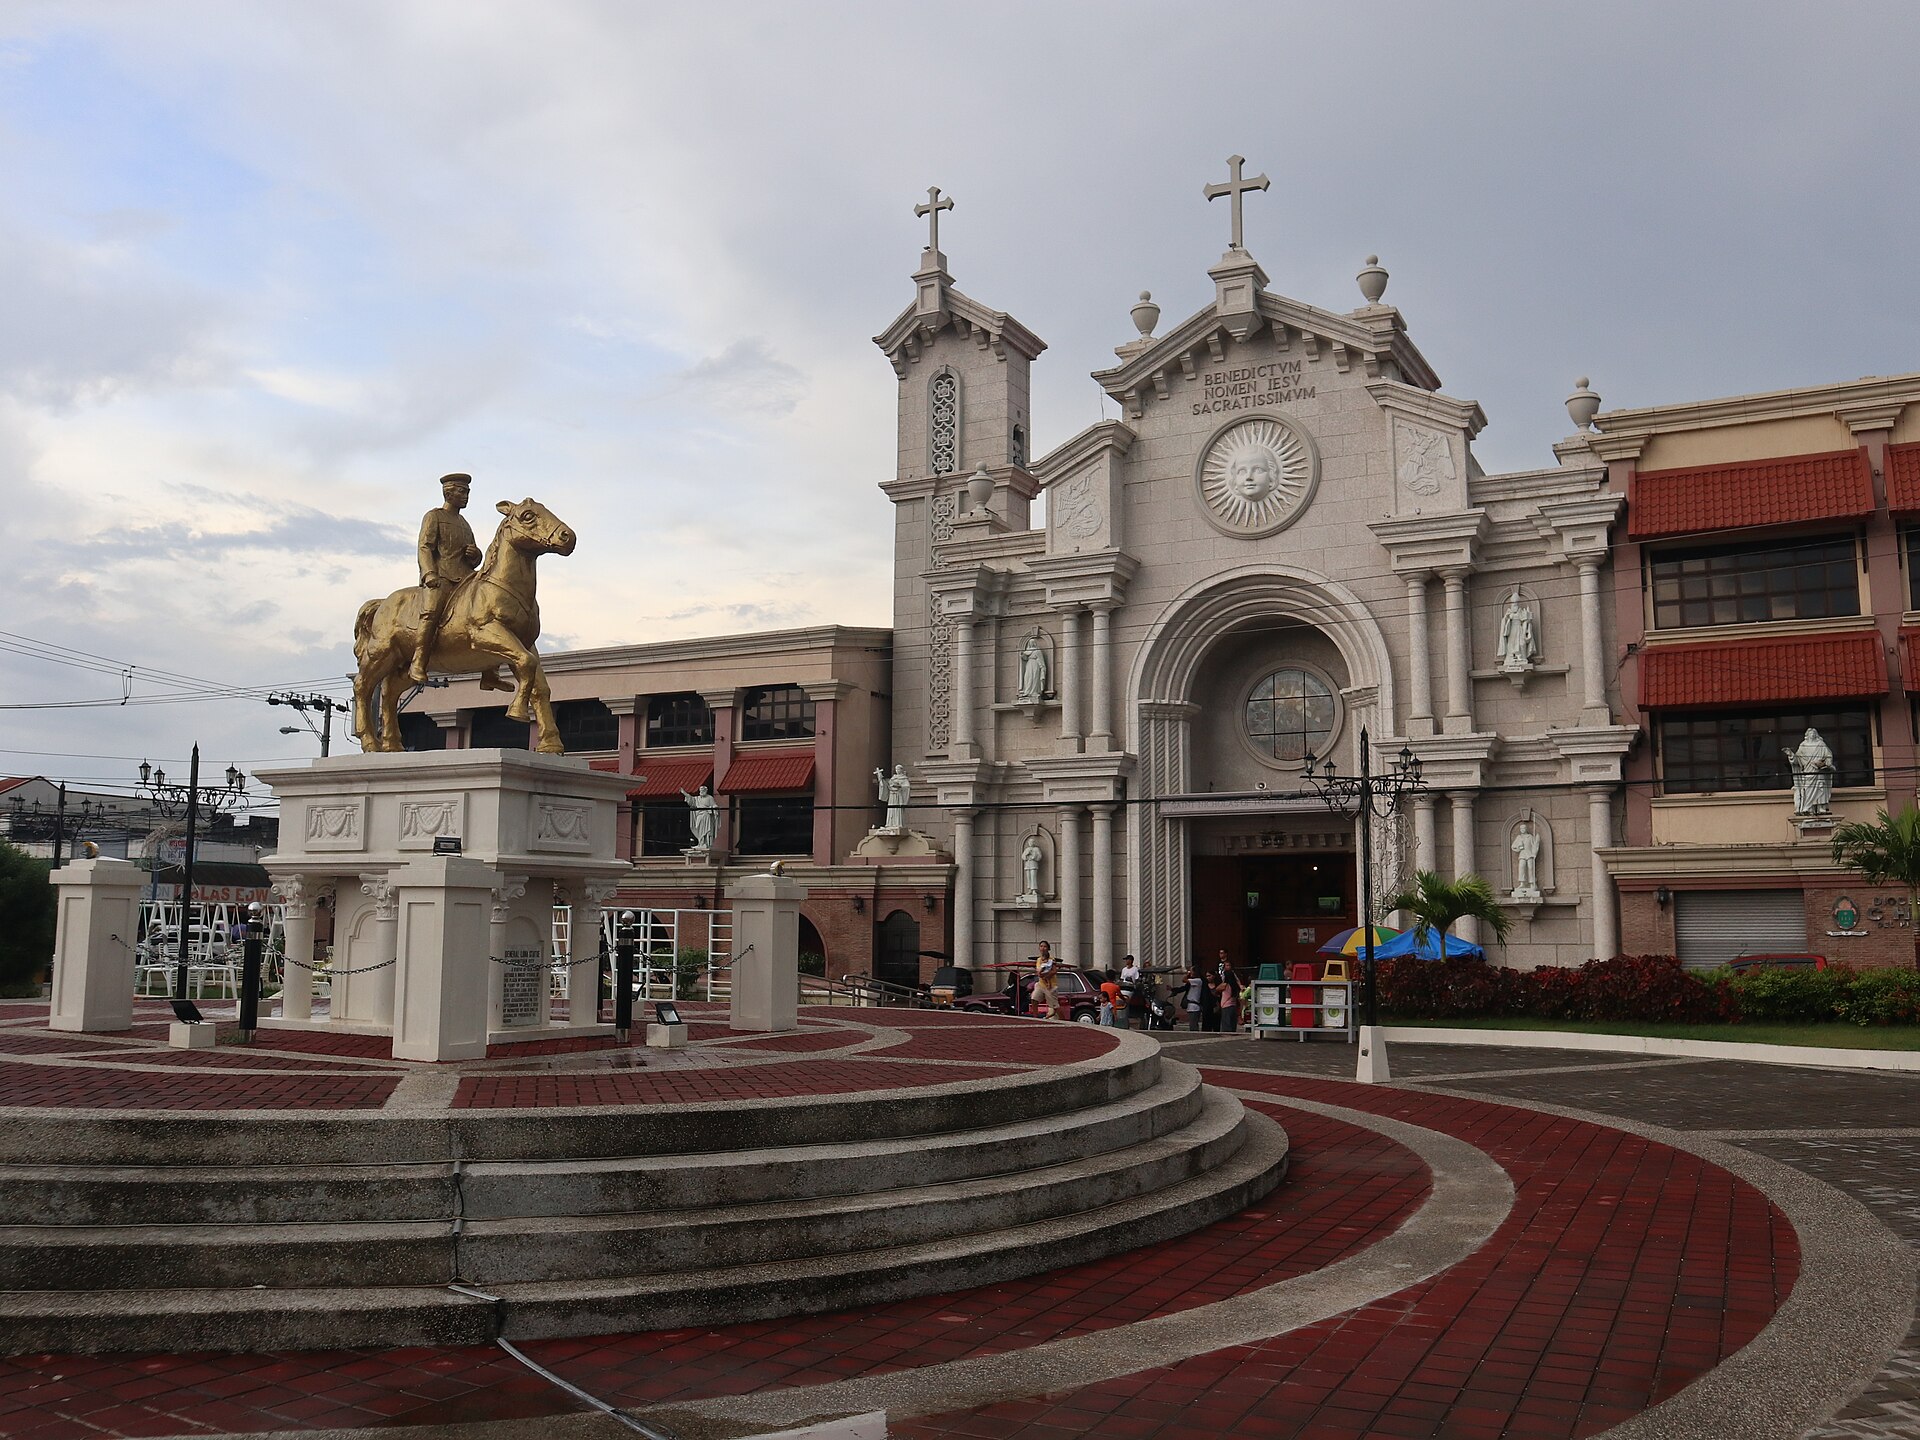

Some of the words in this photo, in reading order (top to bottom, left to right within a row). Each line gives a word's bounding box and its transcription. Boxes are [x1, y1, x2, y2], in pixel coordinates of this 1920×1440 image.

[1204, 360, 1301, 386] BENEDICTVM
[1204, 381, 1257, 400] NOMEN
[1267, 374, 1301, 391] IESV
[1192, 386, 1316, 415] SACRATISSIMVM
